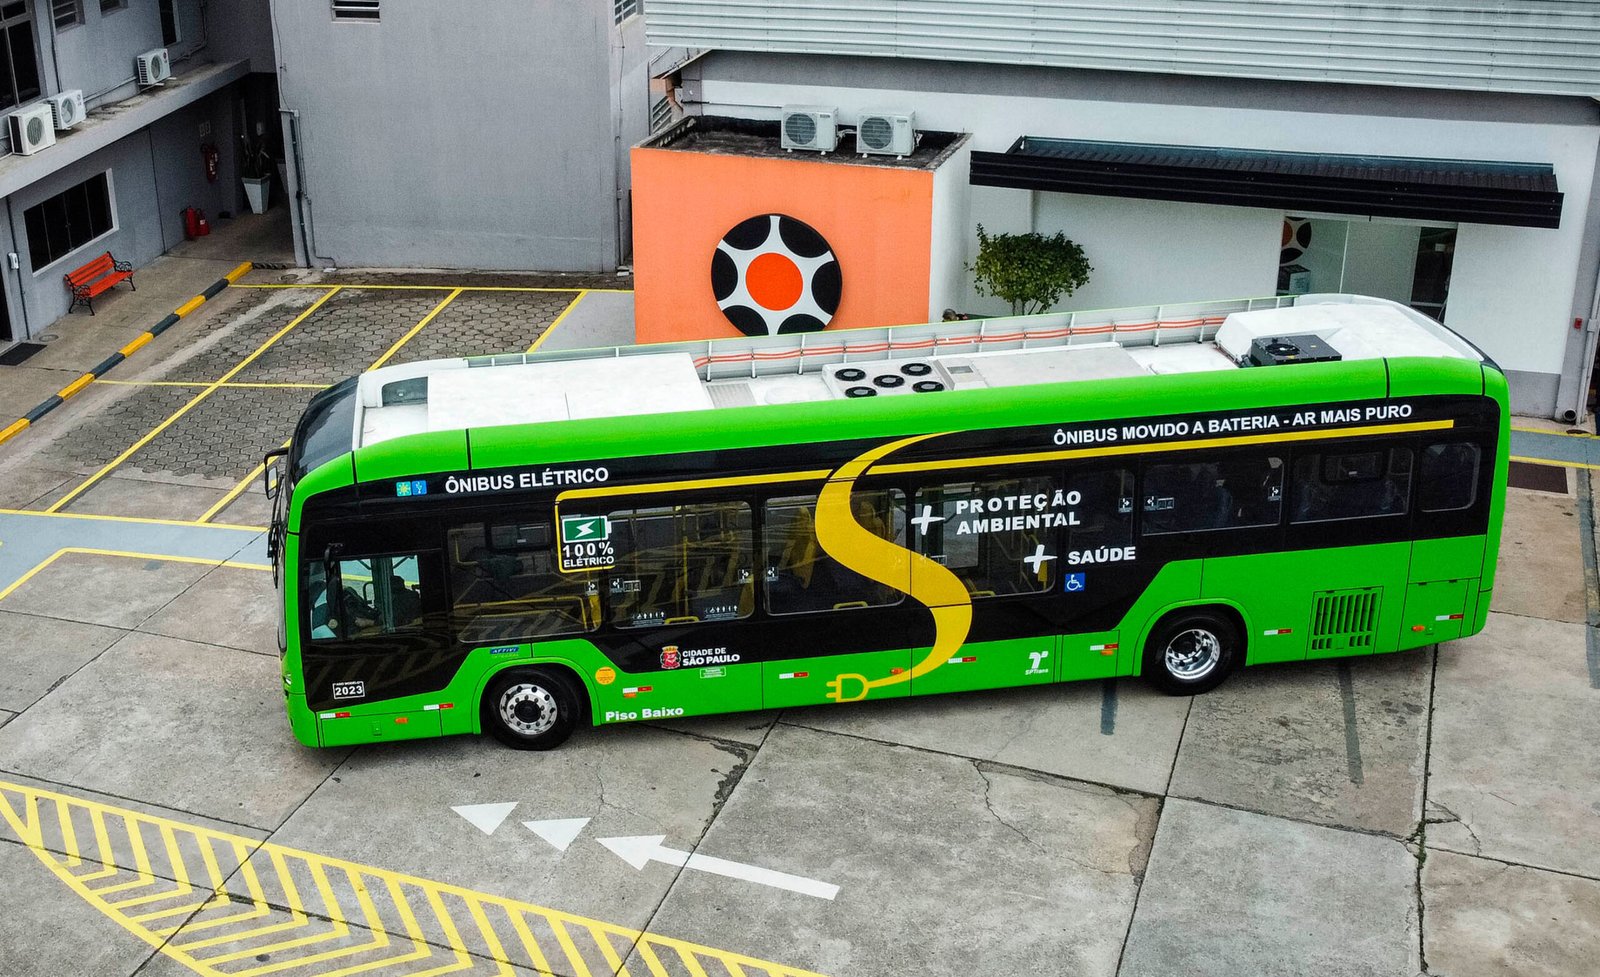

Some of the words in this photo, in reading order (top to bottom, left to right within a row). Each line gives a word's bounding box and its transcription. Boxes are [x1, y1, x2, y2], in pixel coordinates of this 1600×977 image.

[1053, 428, 1118, 445] ÔNIBUS
[1122, 422, 1189, 440] MOVIDO
[1192, 421, 1205, 434] A
[1208, 415, 1280, 432] BATERIA
[1292, 412, 1316, 426] AR
[1320, 408, 1361, 424] MAIS
[1365, 404, 1412, 420] PURO
[445, 475, 515, 494] ÔNIBUS
[519, 467, 609, 488] ELÉTRICO
[956, 489, 1081, 515] PROTEÇÃO
[956, 511, 1081, 536] AMBIENTAL
[562, 541, 614, 558] 100%
[1067, 546, 1136, 566] SAÚDE
[563, 556, 615, 568] ELÉTRICO
[682, 648, 713, 657] CIDADE
[714, 647, 727, 655] DE
[682, 656, 705, 667] SÃO
[705, 654, 741, 665] PAULO
[335, 685, 363, 696] 2023
[605, 711, 638, 722] Piso
[642, 706, 684, 719] Baixo
